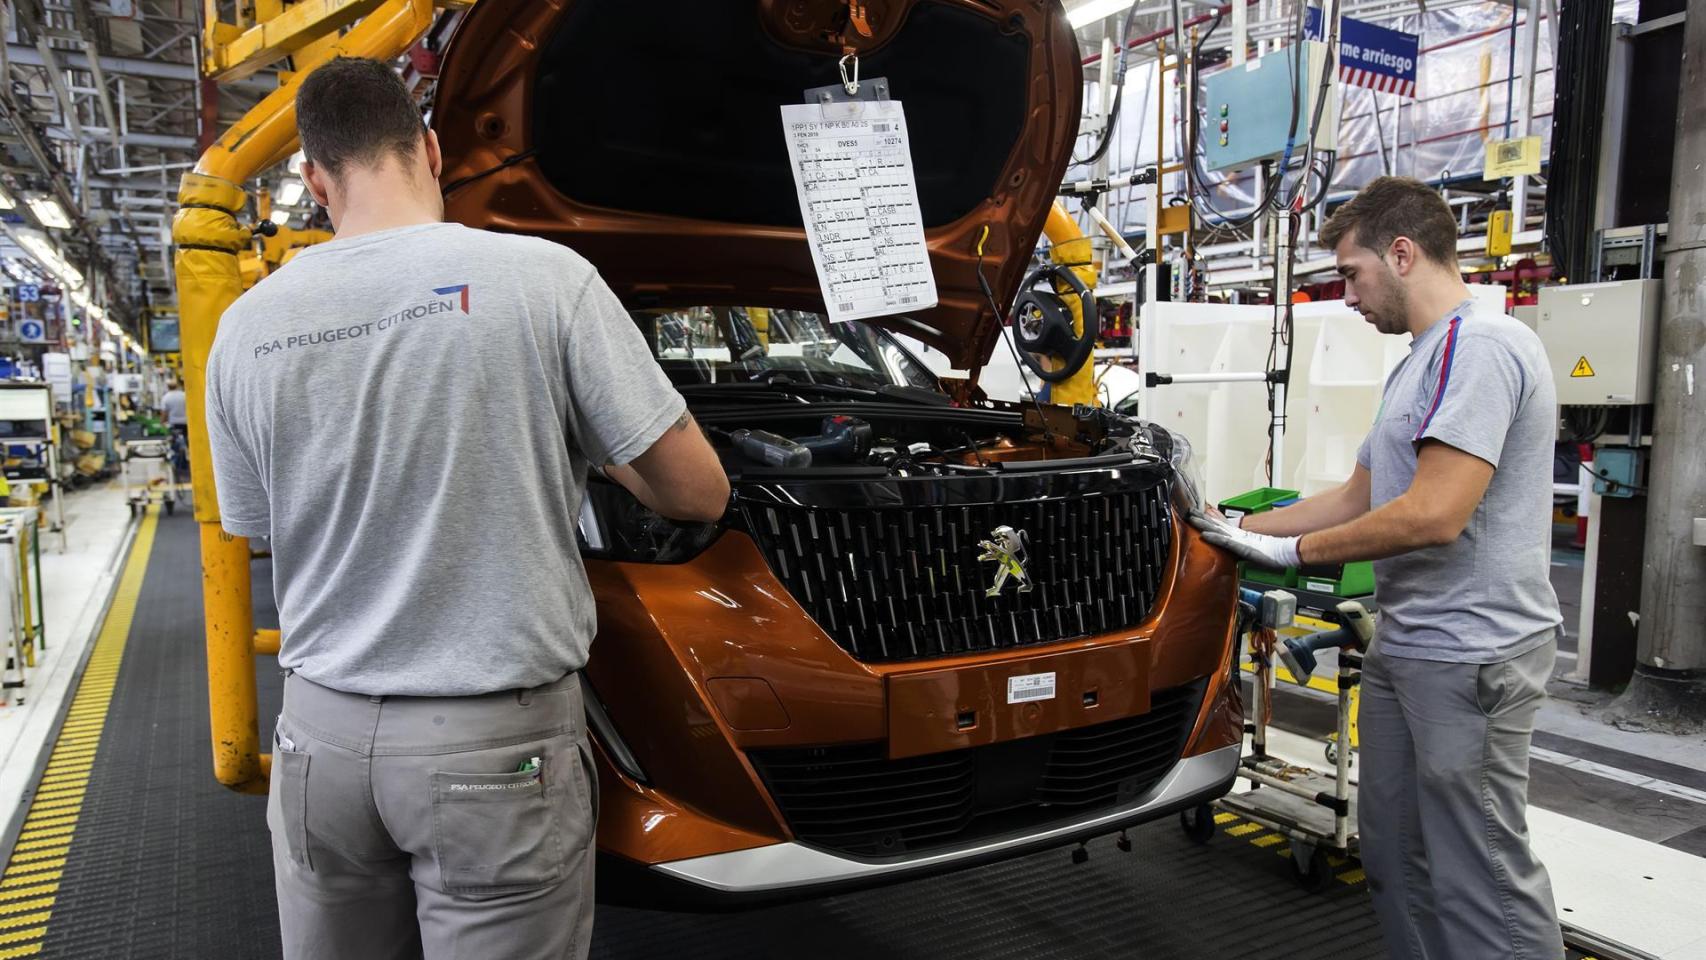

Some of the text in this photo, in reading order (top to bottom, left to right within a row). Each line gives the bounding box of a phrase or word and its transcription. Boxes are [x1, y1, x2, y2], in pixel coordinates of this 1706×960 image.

[1341, 42, 1360, 58] me
[1362, 48, 1412, 74] arriesgo
[878, 207, 896, 215] CASB
[19, 286, 39, 302] 53
[254, 300, 453, 358] PSA PEUGEOT CITROËN
